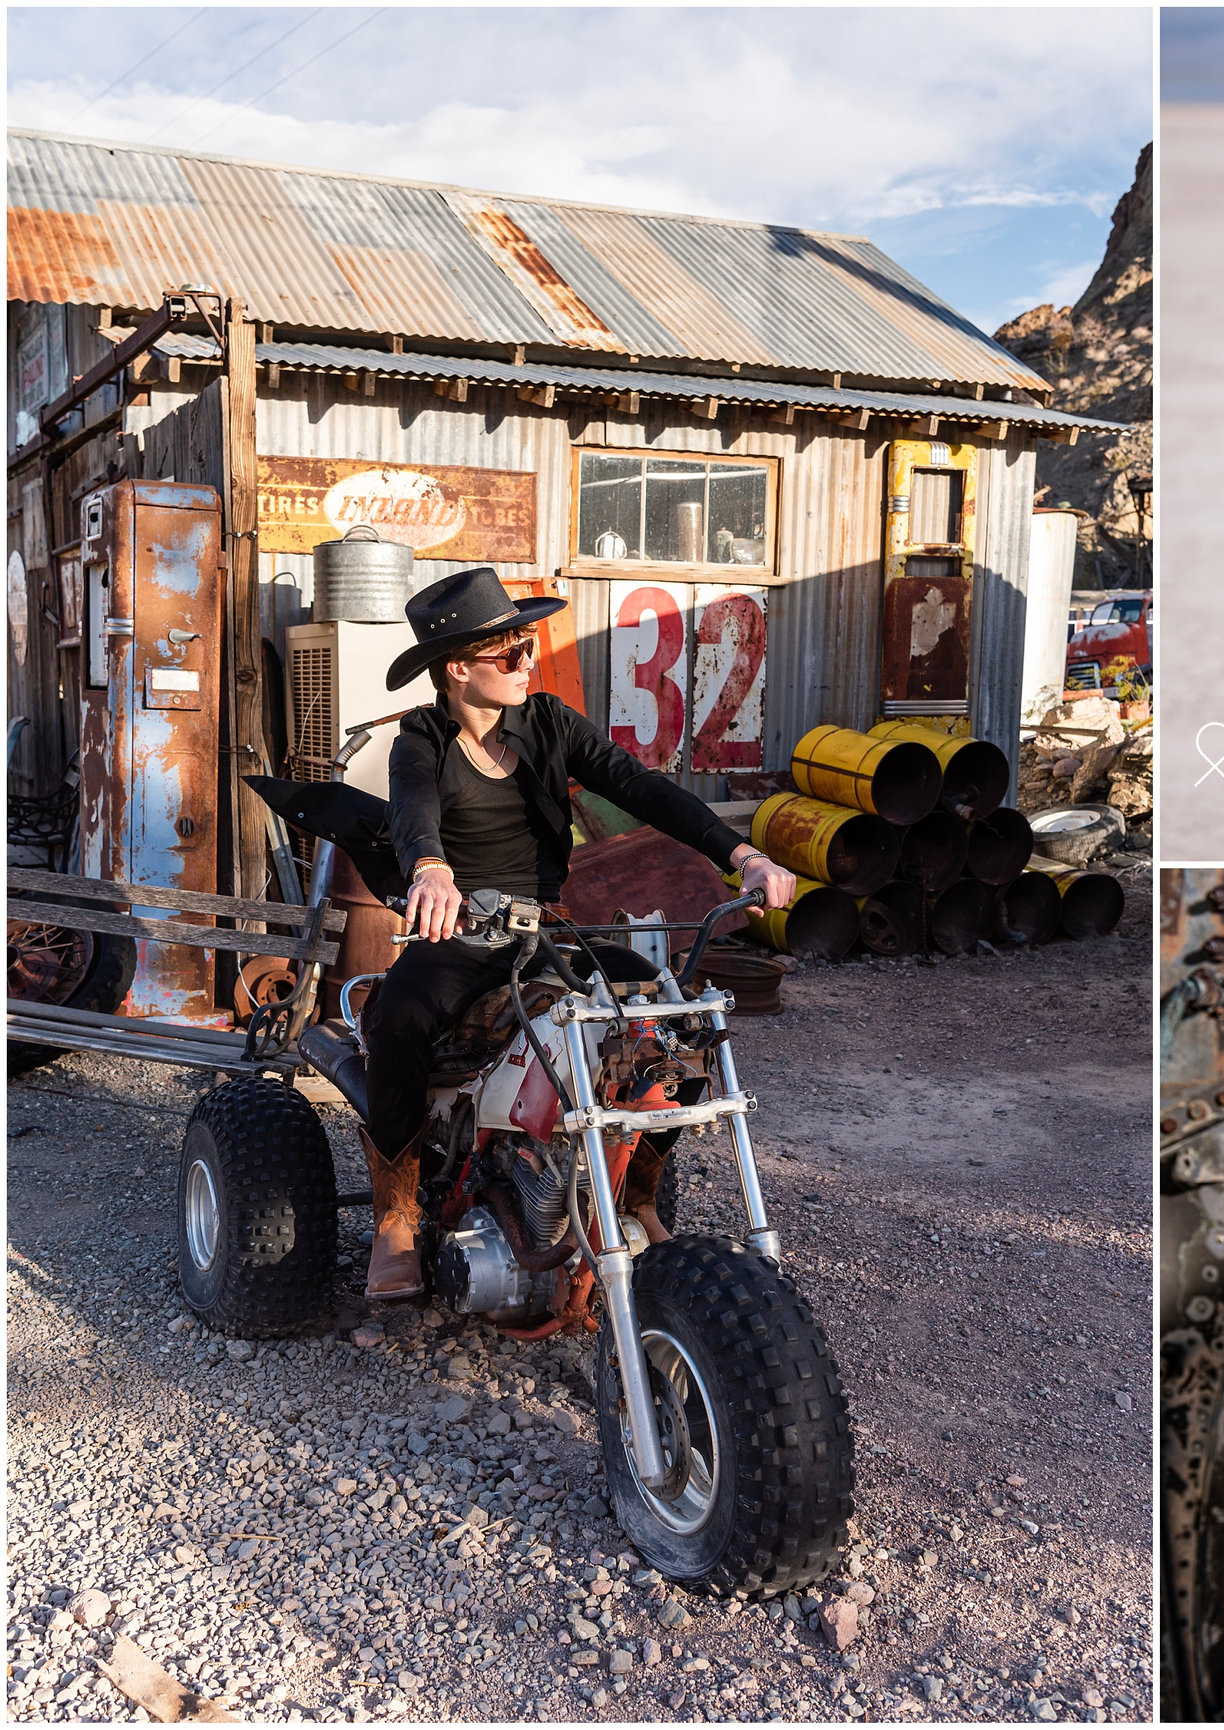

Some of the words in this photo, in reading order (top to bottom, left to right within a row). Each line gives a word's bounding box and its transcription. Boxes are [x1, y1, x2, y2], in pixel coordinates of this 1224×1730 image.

[257, 495, 319, 515] TIRES
[335, 495, 458, 526] INLAND
[469, 506, 531, 527] TUBES
[610, 586, 767, 768] 32
